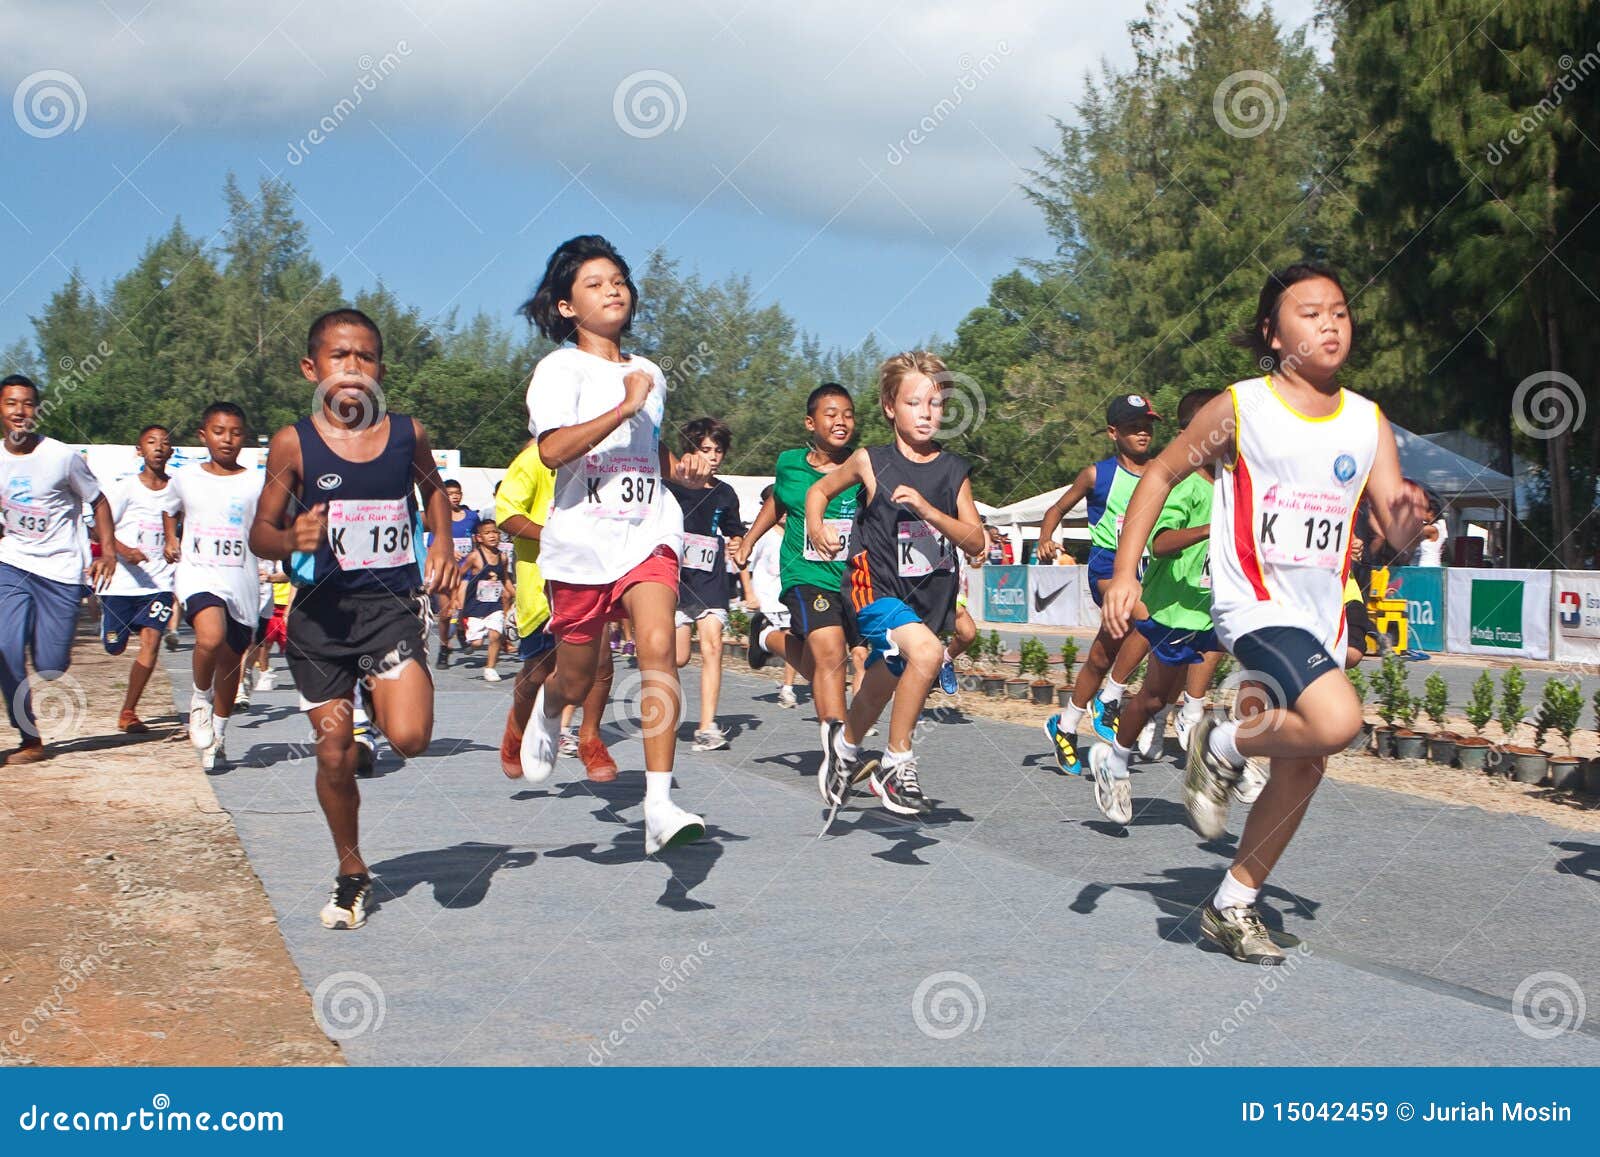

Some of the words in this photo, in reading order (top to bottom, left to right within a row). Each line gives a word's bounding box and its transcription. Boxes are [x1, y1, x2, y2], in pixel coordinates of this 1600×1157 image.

[599, 464, 618, 473] Kids
[621, 464, 637, 472] Run
[587, 477, 602, 503] K
[621, 477, 656, 504] 387
[19, 515, 46, 532] 433
[345, 512, 365, 522] Kids
[368, 512, 387, 521] Run
[331, 527, 346, 555] K
[369, 523, 410, 553] 136
[1260, 512, 1279, 544] K
[1304, 517, 1344, 552] 131
[193, 537, 201, 554] K
[214, 539, 243, 556] 185
[902, 541, 913, 565] K
